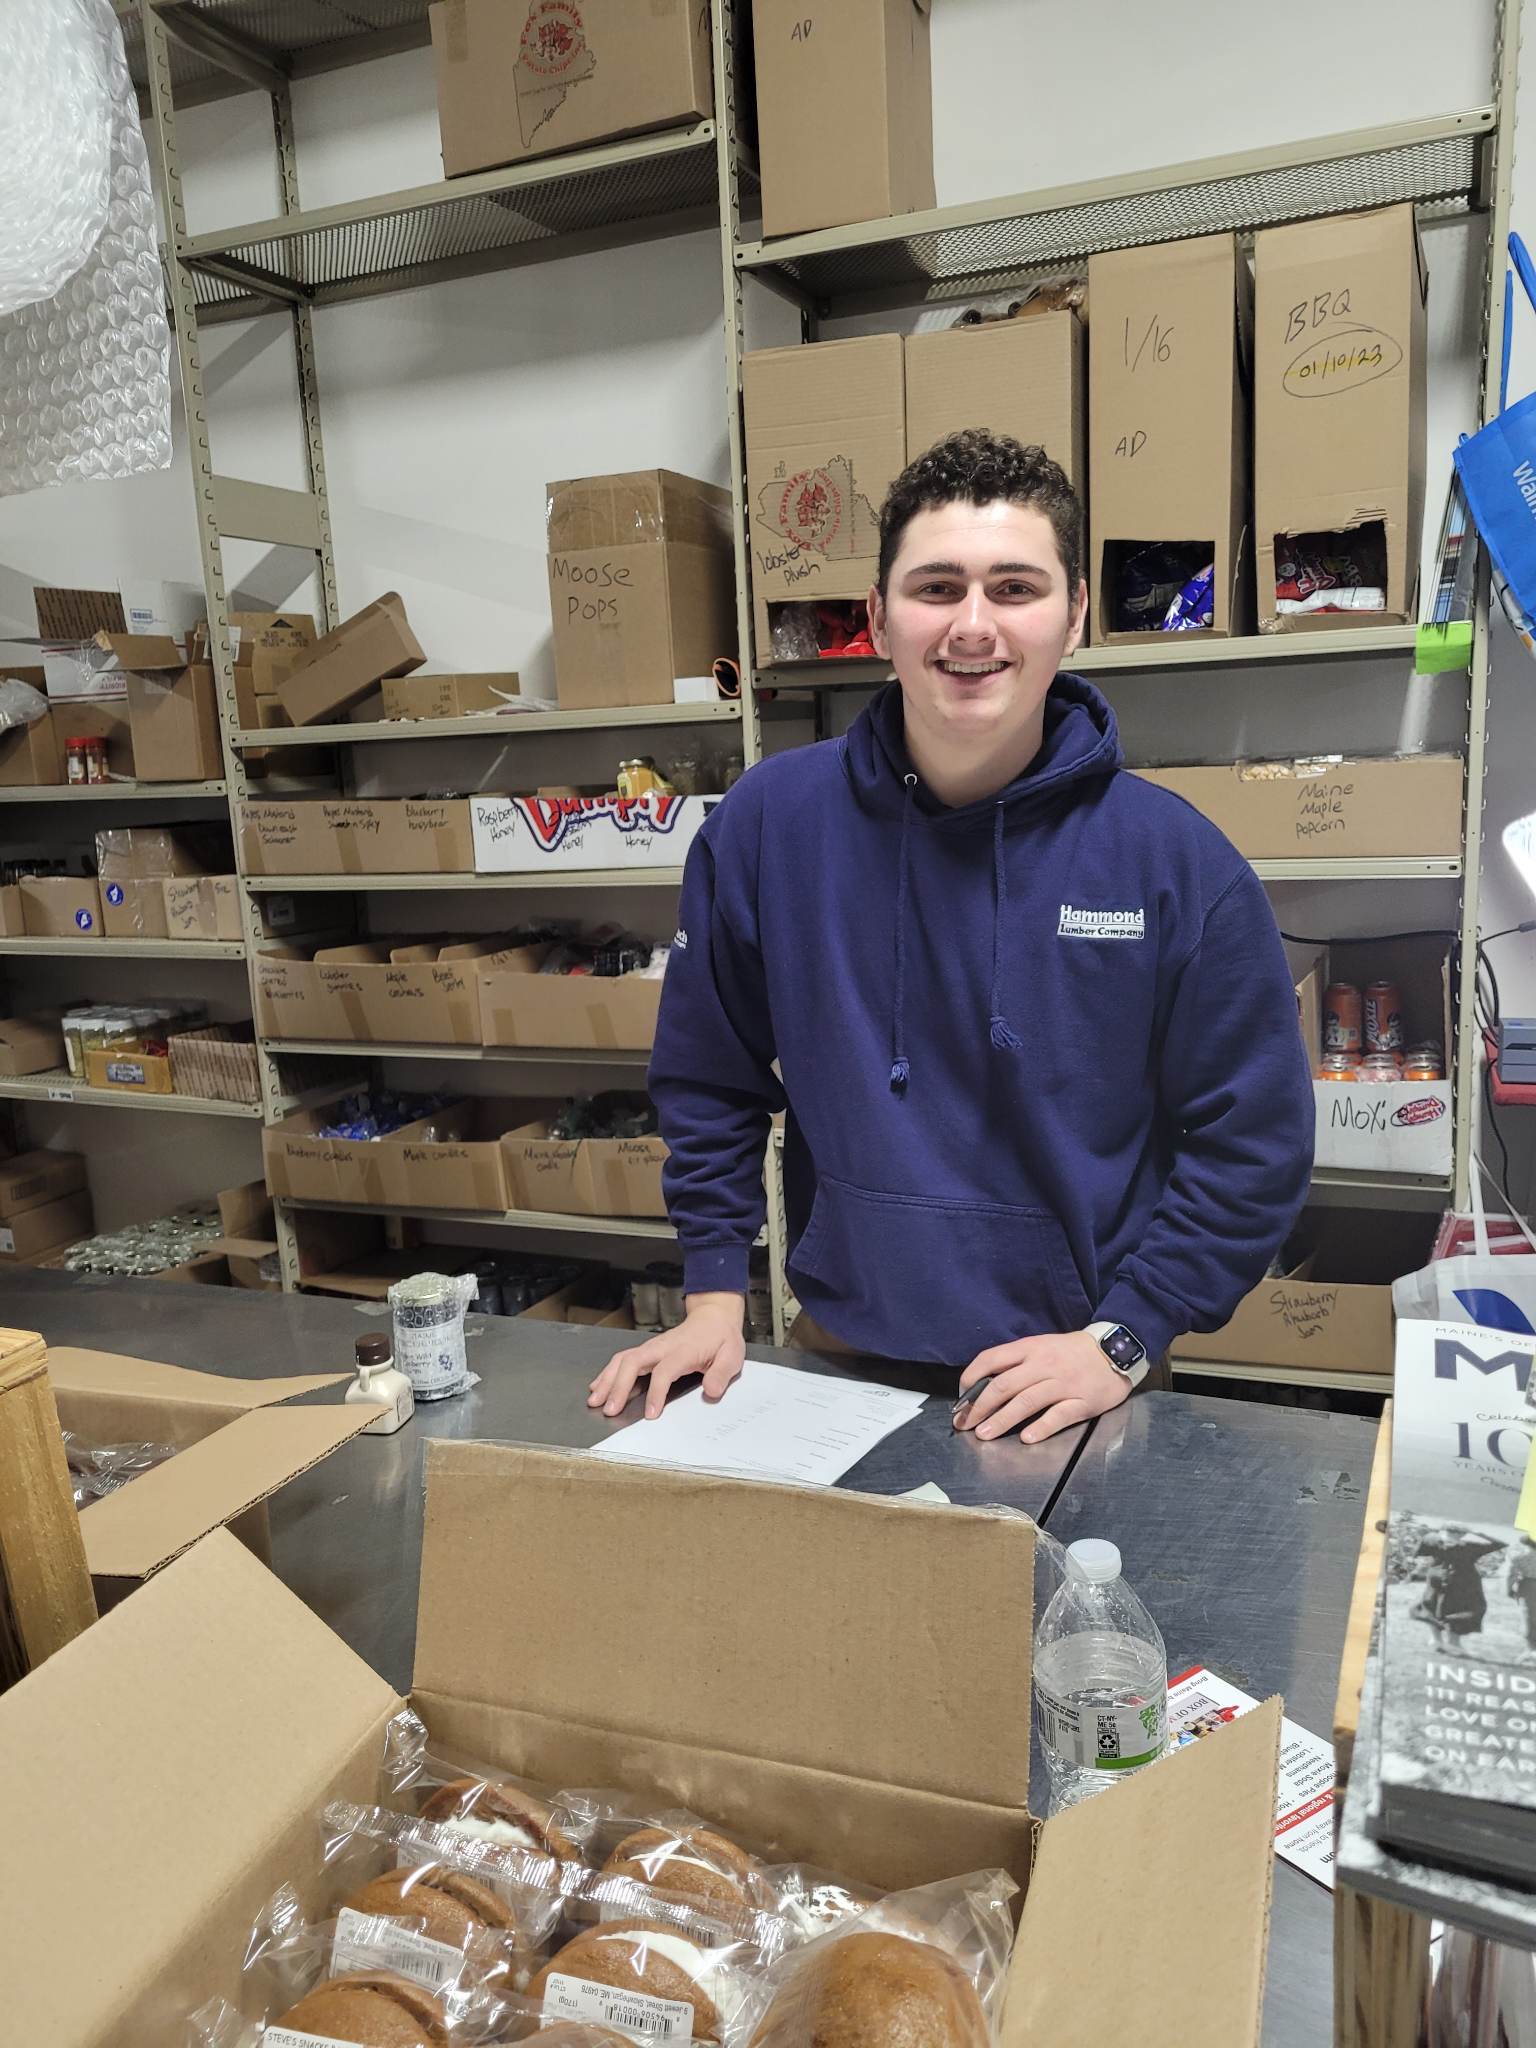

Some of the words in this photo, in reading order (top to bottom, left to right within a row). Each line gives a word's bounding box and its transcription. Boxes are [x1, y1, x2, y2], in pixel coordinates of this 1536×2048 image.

[790, 18, 812, 43] AD
[1284, 288, 1352, 345] BBQ
[1124, 314, 1175, 373] 1/16
[1299, 343, 1384, 379] 01/10/23
[1114, 430, 1148, 458] AD
[553, 557, 635, 588] Moose
[1297, 782, 1354, 801] Maine
[1300, 798, 1345, 820] Maple
[1060, 904, 1144, 924] Hammond
[1060, 923, 1097, 936] Lumber
[1097, 926, 1144, 938] Company
[1190, 1676, 1209, 1686] Bring
[1187, 1698, 1209, 1712] BOX
[1424, 1703, 1499, 1729] LOVE
[1424, 1745, 1468, 1763] ON
[1285, 1755, 1322, 1778] Needhams
[1312, 1761, 1333, 1776] Moxie
[1293, 1774, 1314, 1787] Soda
[1298, 1786, 1316, 1798] Pies
[1299, 1796, 1328, 1817] regional
[599, 1989, 611, 1999] ME
[613, 2003, 638, 2016] 00018
[641, 2010, 666, 2022] 94506
